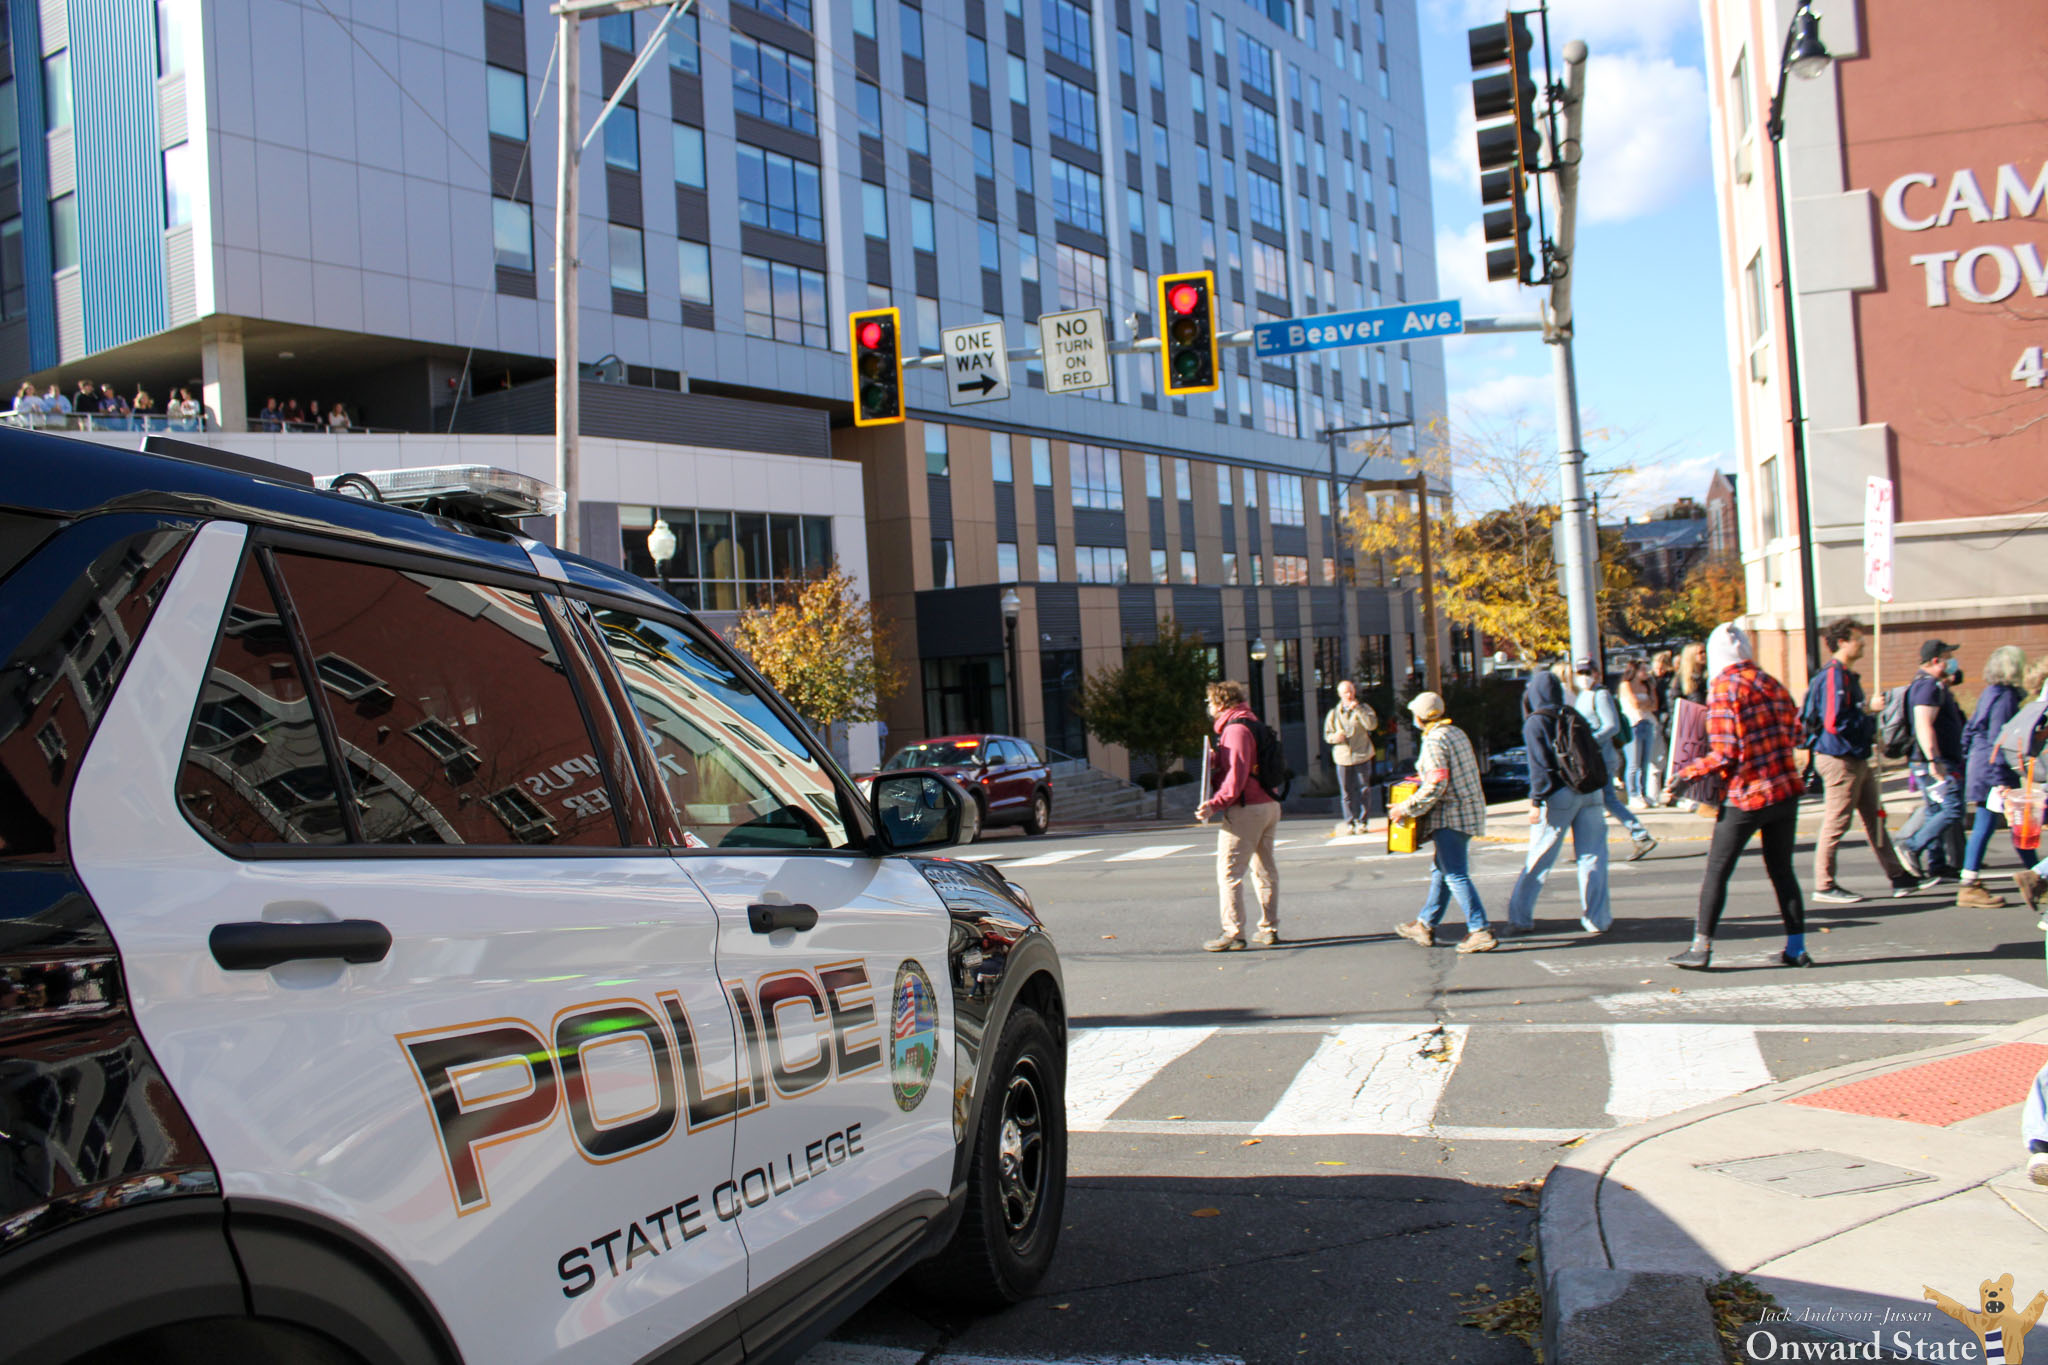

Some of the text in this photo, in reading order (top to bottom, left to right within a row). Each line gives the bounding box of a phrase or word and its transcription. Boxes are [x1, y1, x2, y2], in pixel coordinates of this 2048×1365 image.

[1056, 318, 1088, 338] NO
[1257, 311, 1461, 350] E. Beaver Ave.
[955, 331, 993, 352] ONE
[1055, 338, 1093, 354] TURN
[956, 352, 994, 372] WAY
[1066, 355, 1086, 369] ON
[1063, 370, 1093, 386] RED
[394, 957, 884, 1218] POLICE
[557, 1122, 865, 1299] STATE COLLEGE
